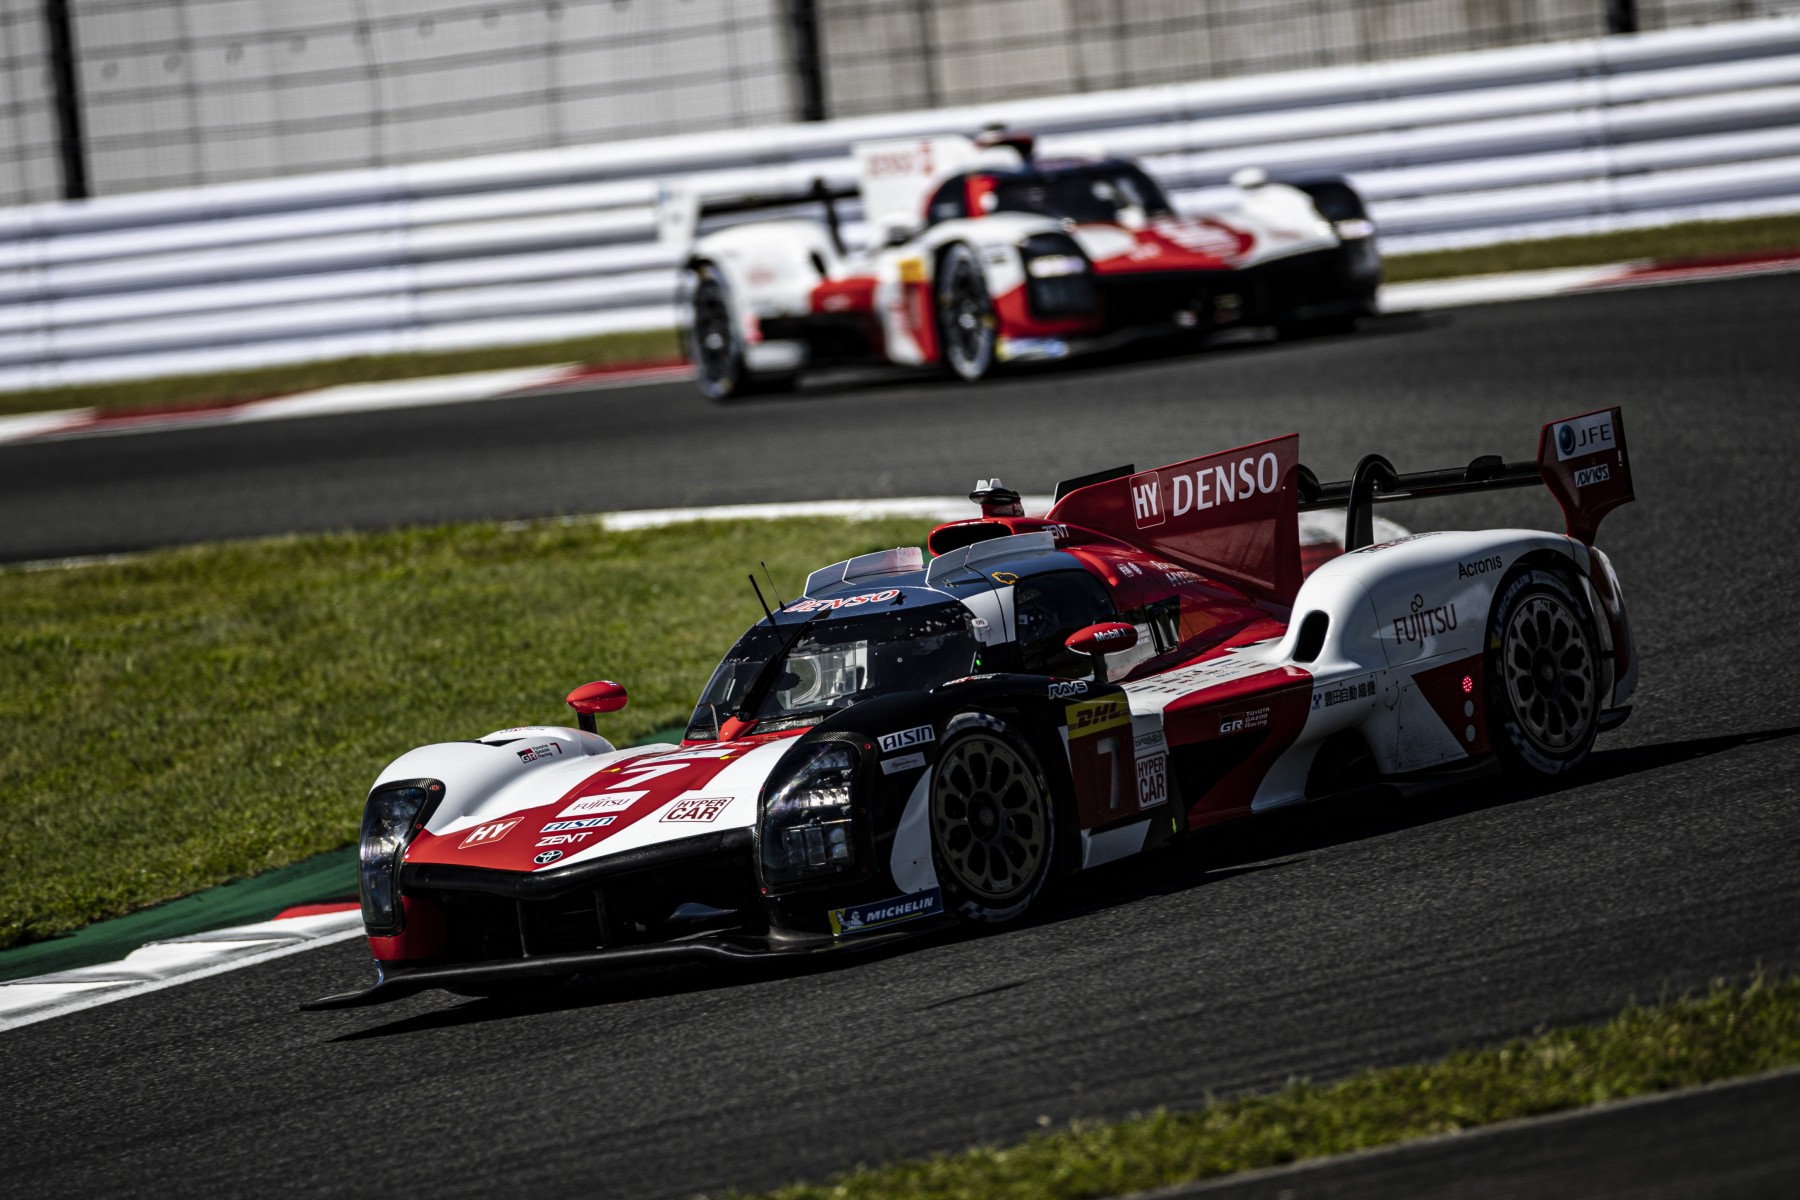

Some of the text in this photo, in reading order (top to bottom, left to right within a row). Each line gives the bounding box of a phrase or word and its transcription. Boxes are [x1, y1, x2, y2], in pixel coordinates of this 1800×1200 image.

[1578, 424, 1611, 447] JFE
[1132, 452, 1279, 519] HY DENSO
[1458, 555, 1503, 580] Acronis
[783, 590, 900, 612] DENSO
[1094, 629, 1119, 642] Mobil
[1392, 604, 1457, 648] FUJITSU
[1048, 681, 1088, 700] RAYS
[1076, 702, 1121, 727] DHL
[1220, 720, 1243, 732] GR
[883, 727, 933, 750] AISIN
[521, 752, 537, 762] GR
[1138, 757, 1164, 778] HYPER
[1097, 736, 1120, 809] 7
[1140, 774, 1165, 803] CAR
[572, 798, 630, 811] FUJITSU
[667, 807, 719, 819] CAR
[677, 799, 728, 807] HYPER
[465, 821, 517, 843] HY
[543, 817, 614, 831] AISIN
[535, 832, 593, 846] ZENT
[866, 897, 933, 922] MICHELIN
